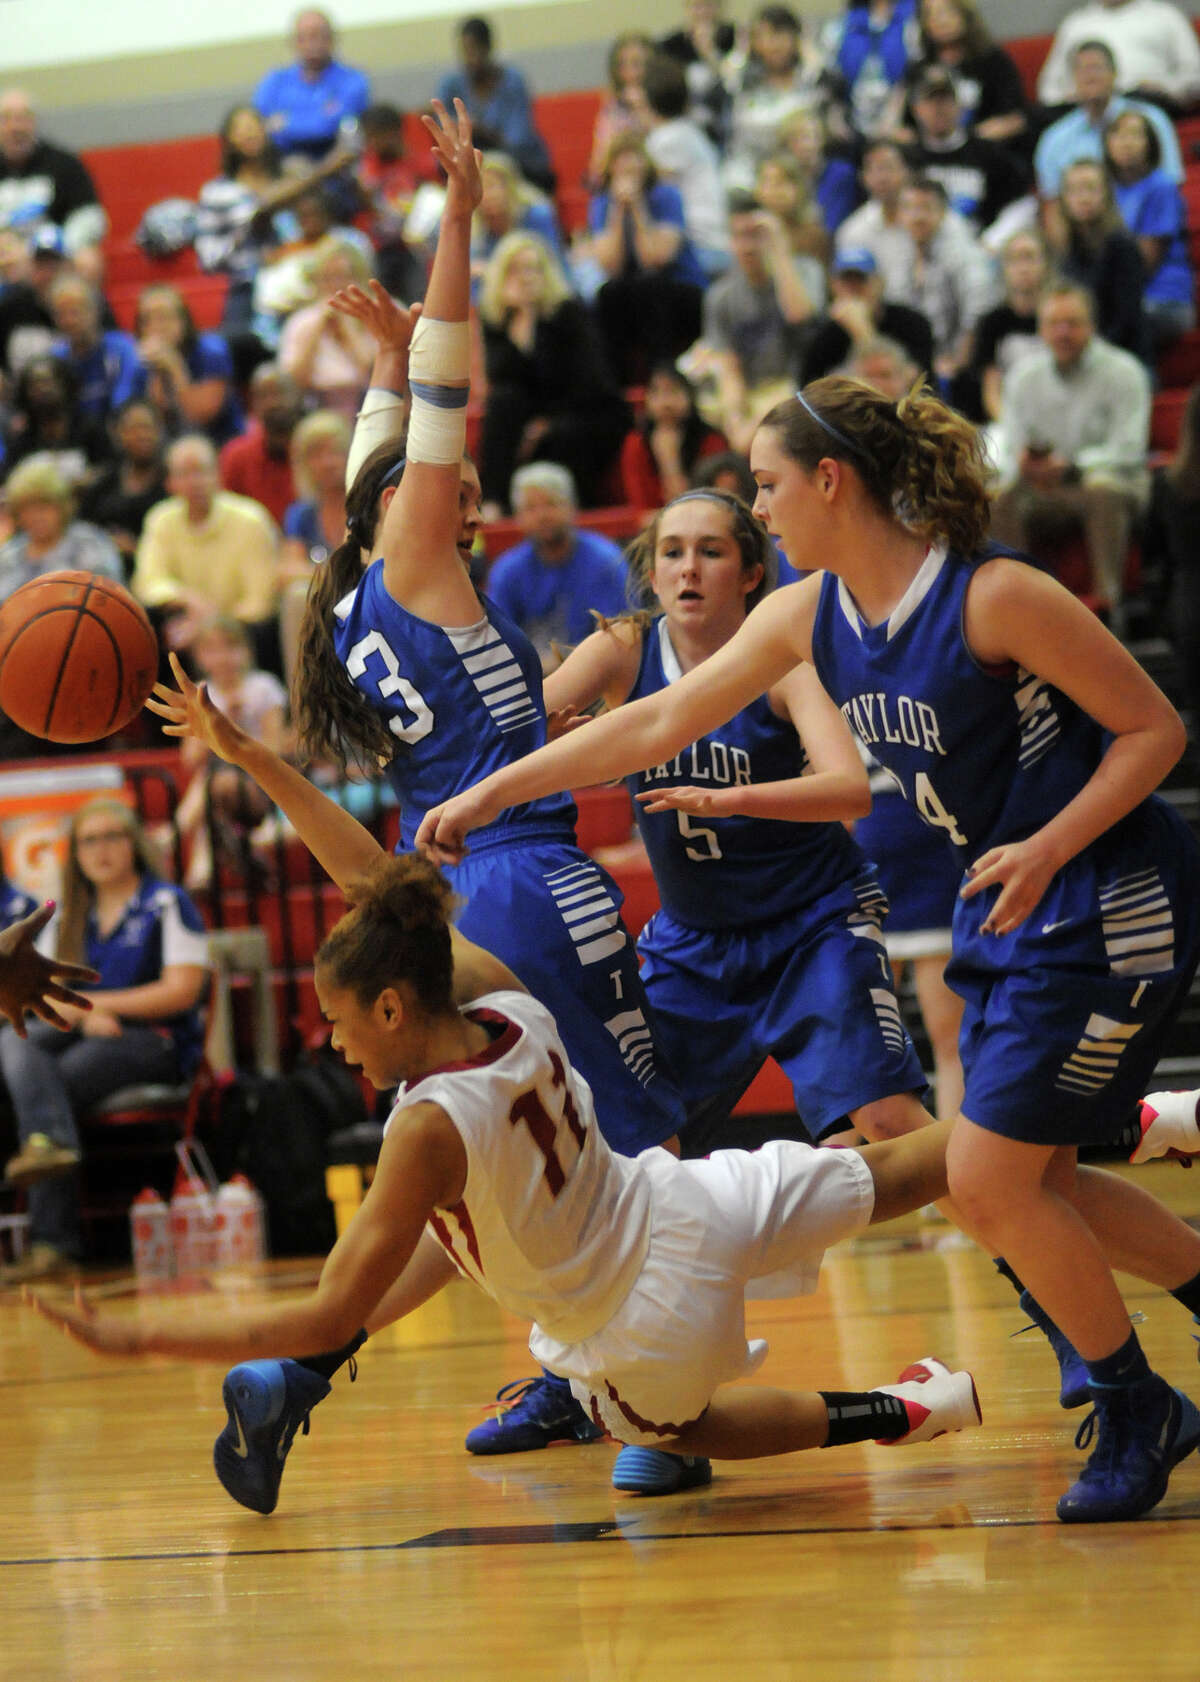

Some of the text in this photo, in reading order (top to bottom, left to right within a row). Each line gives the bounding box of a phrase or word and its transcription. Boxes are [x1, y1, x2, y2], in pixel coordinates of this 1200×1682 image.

[345, 628, 435, 746] 3
[840, 692, 948, 757] TAYLOR
[676, 808, 723, 862] 5
[609, 968, 624, 1000] T
